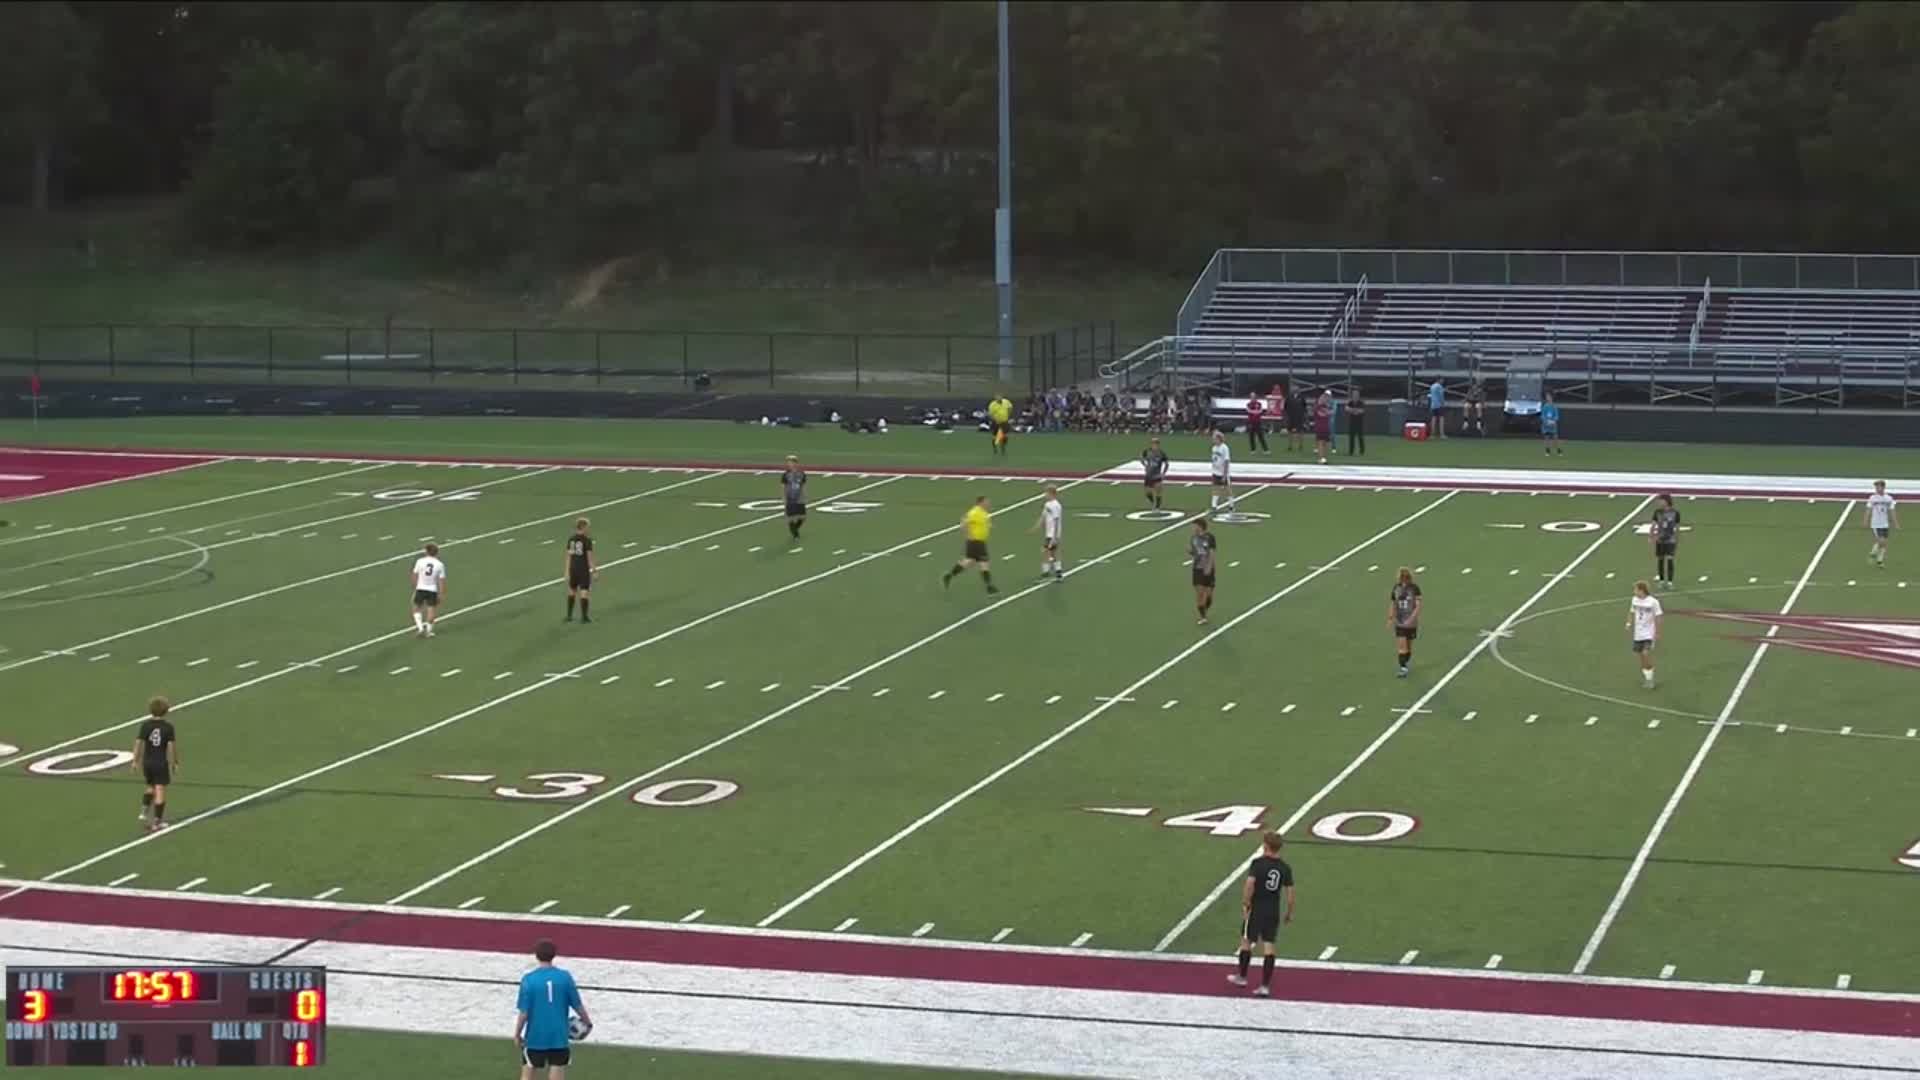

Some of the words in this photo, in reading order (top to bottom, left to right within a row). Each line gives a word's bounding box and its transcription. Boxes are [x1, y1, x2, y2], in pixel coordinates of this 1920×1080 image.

[425, 563, 434, 577] 3
[148, 728, 161, 747] 4
[1265, 869, 1281, 891] 3
[545, 979, 554, 1004] 1
